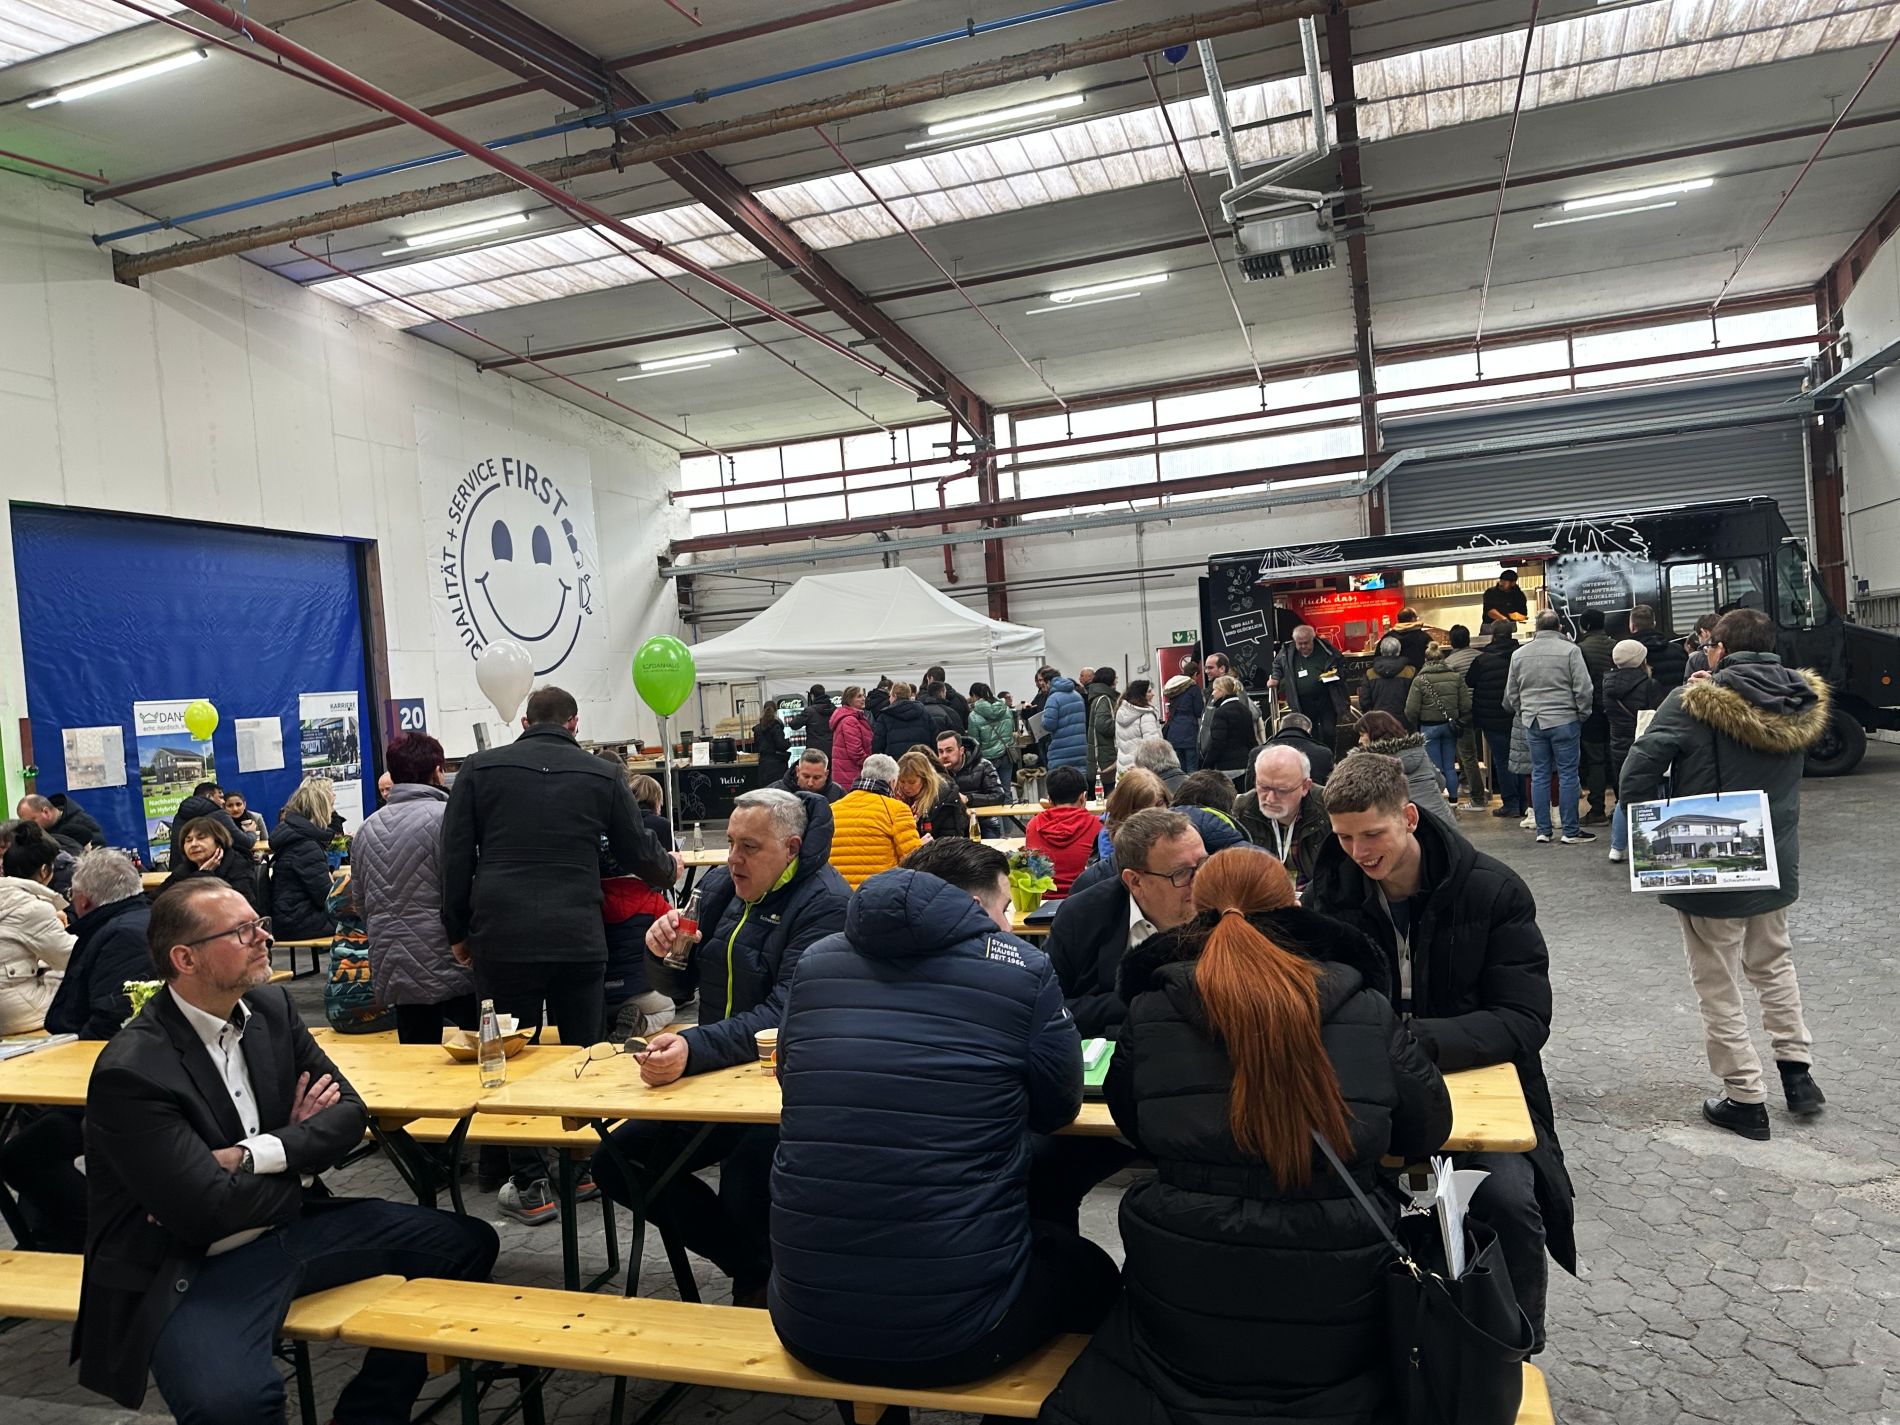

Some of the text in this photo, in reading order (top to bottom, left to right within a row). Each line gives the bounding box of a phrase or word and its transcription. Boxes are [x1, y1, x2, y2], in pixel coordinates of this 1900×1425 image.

[448, 458, 497, 524] SERVICE
[502, 457, 568, 516] FIRST
[441, 546, 483, 660] QUALITÄT
[330, 702, 356, 710] KARRIERE
[400, 707, 424, 730] 20
[991, 946, 1022, 959] HÄUSER.
[992, 939, 1018, 951] STARKE
[990, 953, 1006, 961] SEIT
